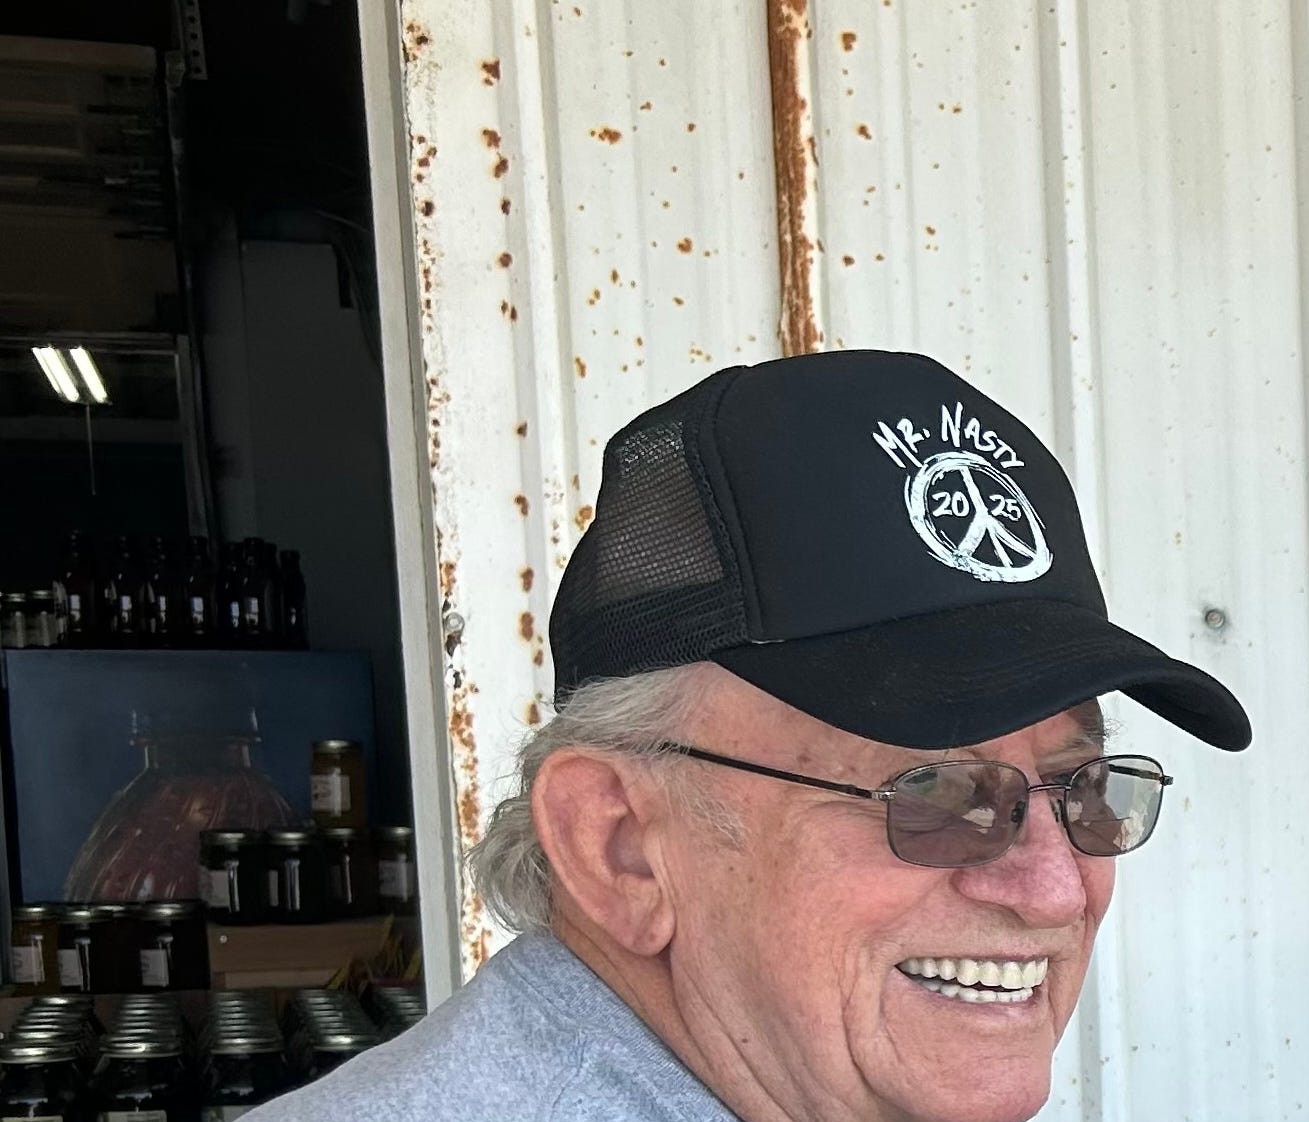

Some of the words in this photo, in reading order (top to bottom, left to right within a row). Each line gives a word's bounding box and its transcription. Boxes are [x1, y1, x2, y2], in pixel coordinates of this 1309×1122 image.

[872, 418, 931, 469] MR.
[940, 401, 1026, 469] NASTY
[931, 491, 970, 517] 20
[989, 494, 1023, 521] 25
